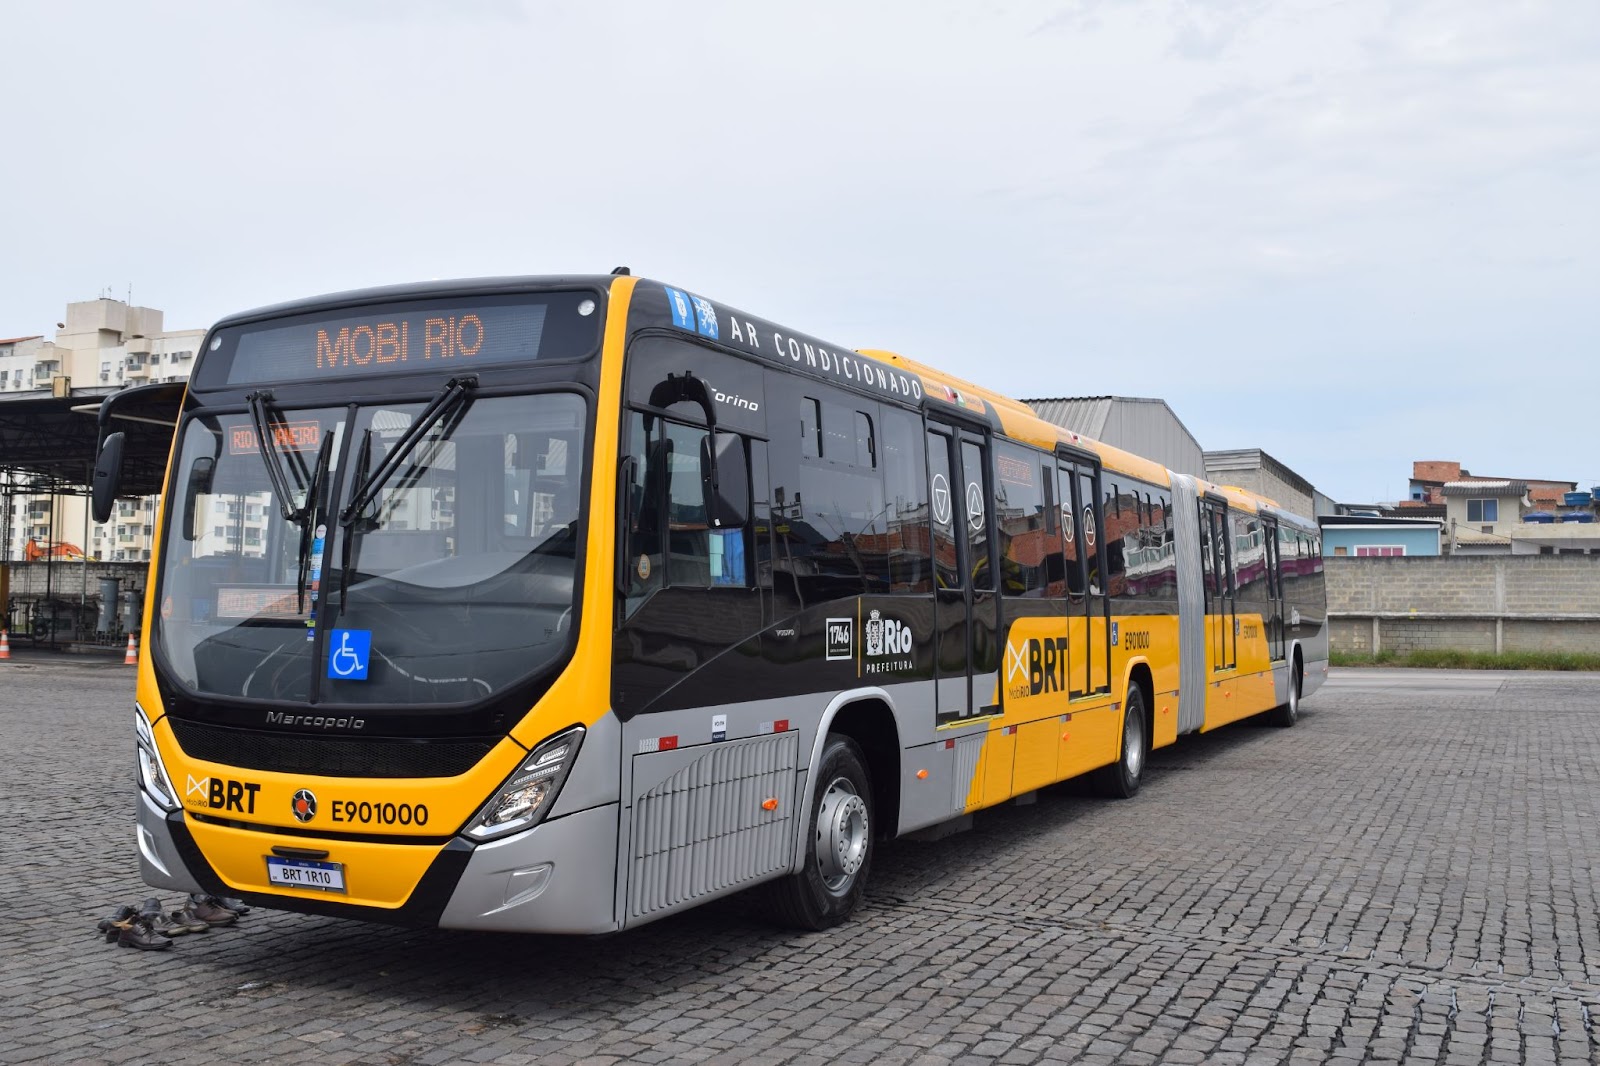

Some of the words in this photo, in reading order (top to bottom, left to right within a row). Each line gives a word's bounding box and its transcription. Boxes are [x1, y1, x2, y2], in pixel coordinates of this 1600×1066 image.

[316, 321, 409, 369] MOBI
[425, 314, 485, 360] RIO
[730, 316, 760, 348] AR
[774, 333, 922, 400] CONDICIONADO
[233, 430, 252, 449] RIO
[775, 628, 795, 637] VOLVO
[829, 625, 850, 645] 1746
[884, 619, 912, 655] Rio
[1125, 631, 1150, 650] E901000
[866, 660, 913, 674] PREFEITURA
[1029, 637, 1068, 696] BRT
[265, 711, 365, 729] Marcopolo
[208, 777, 261, 814] BRT
[332, 800, 429, 826] E901000
[282, 868, 301, 882] BRT
[305, 870, 331, 884] 1R10
